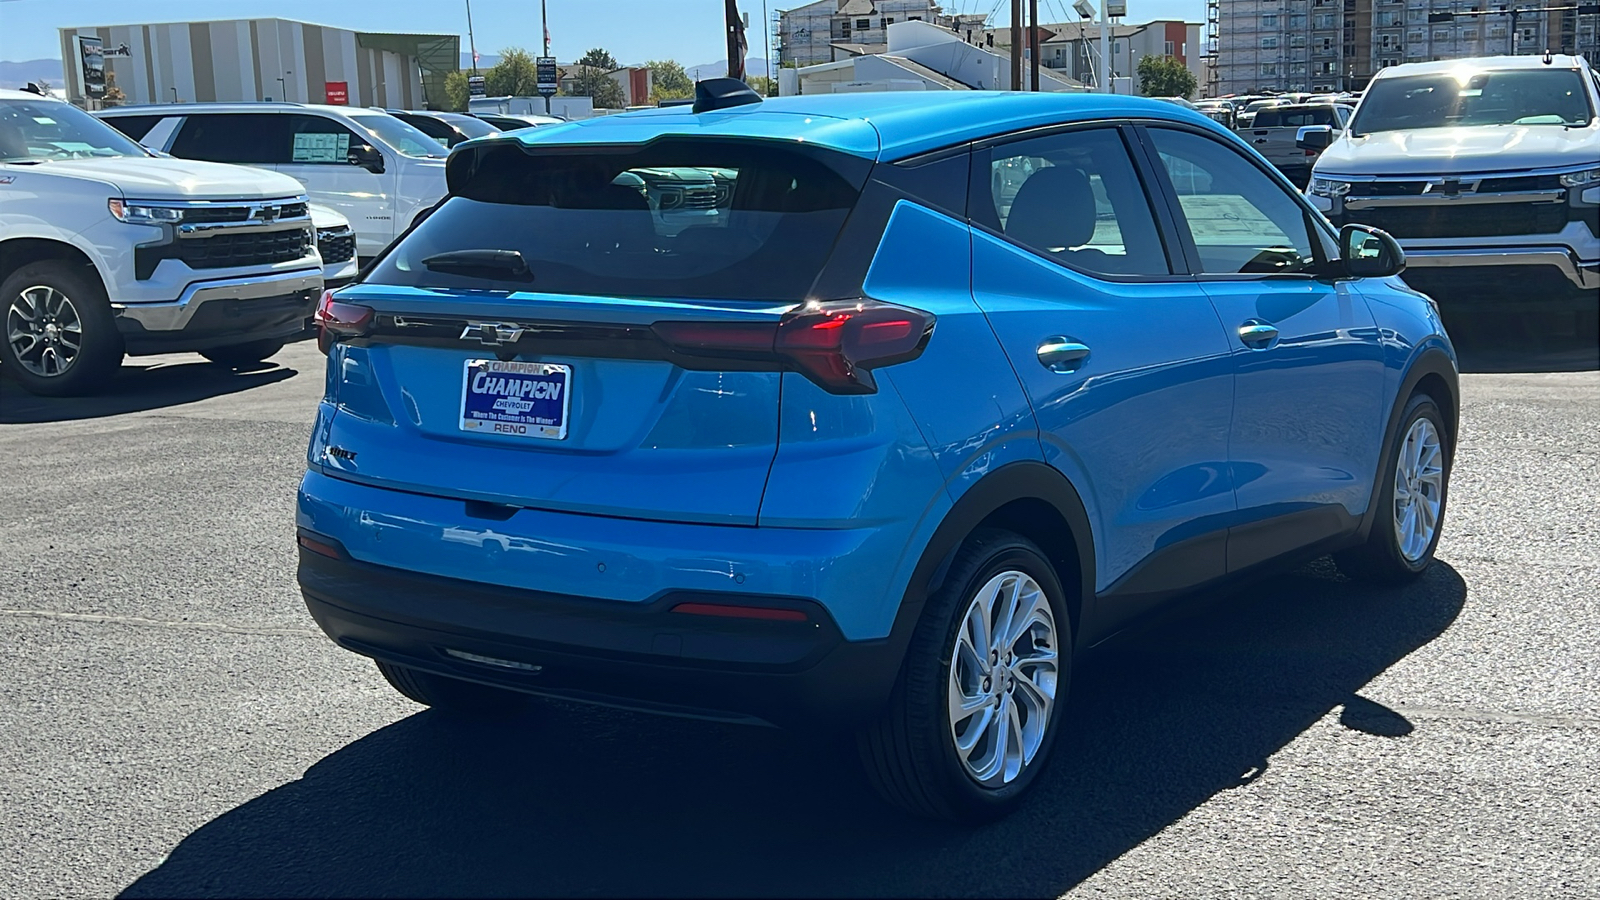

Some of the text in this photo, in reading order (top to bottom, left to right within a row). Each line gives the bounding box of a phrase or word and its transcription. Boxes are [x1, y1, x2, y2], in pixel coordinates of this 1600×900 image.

[492, 361, 541, 374] CHAMPION
[472, 372, 562, 400] CHAMPION
[496, 400, 531, 410] CHEVROLET
[488, 412, 497, 420] The
[498, 413, 520, 422] Customer
[494, 423, 527, 434] RENO
